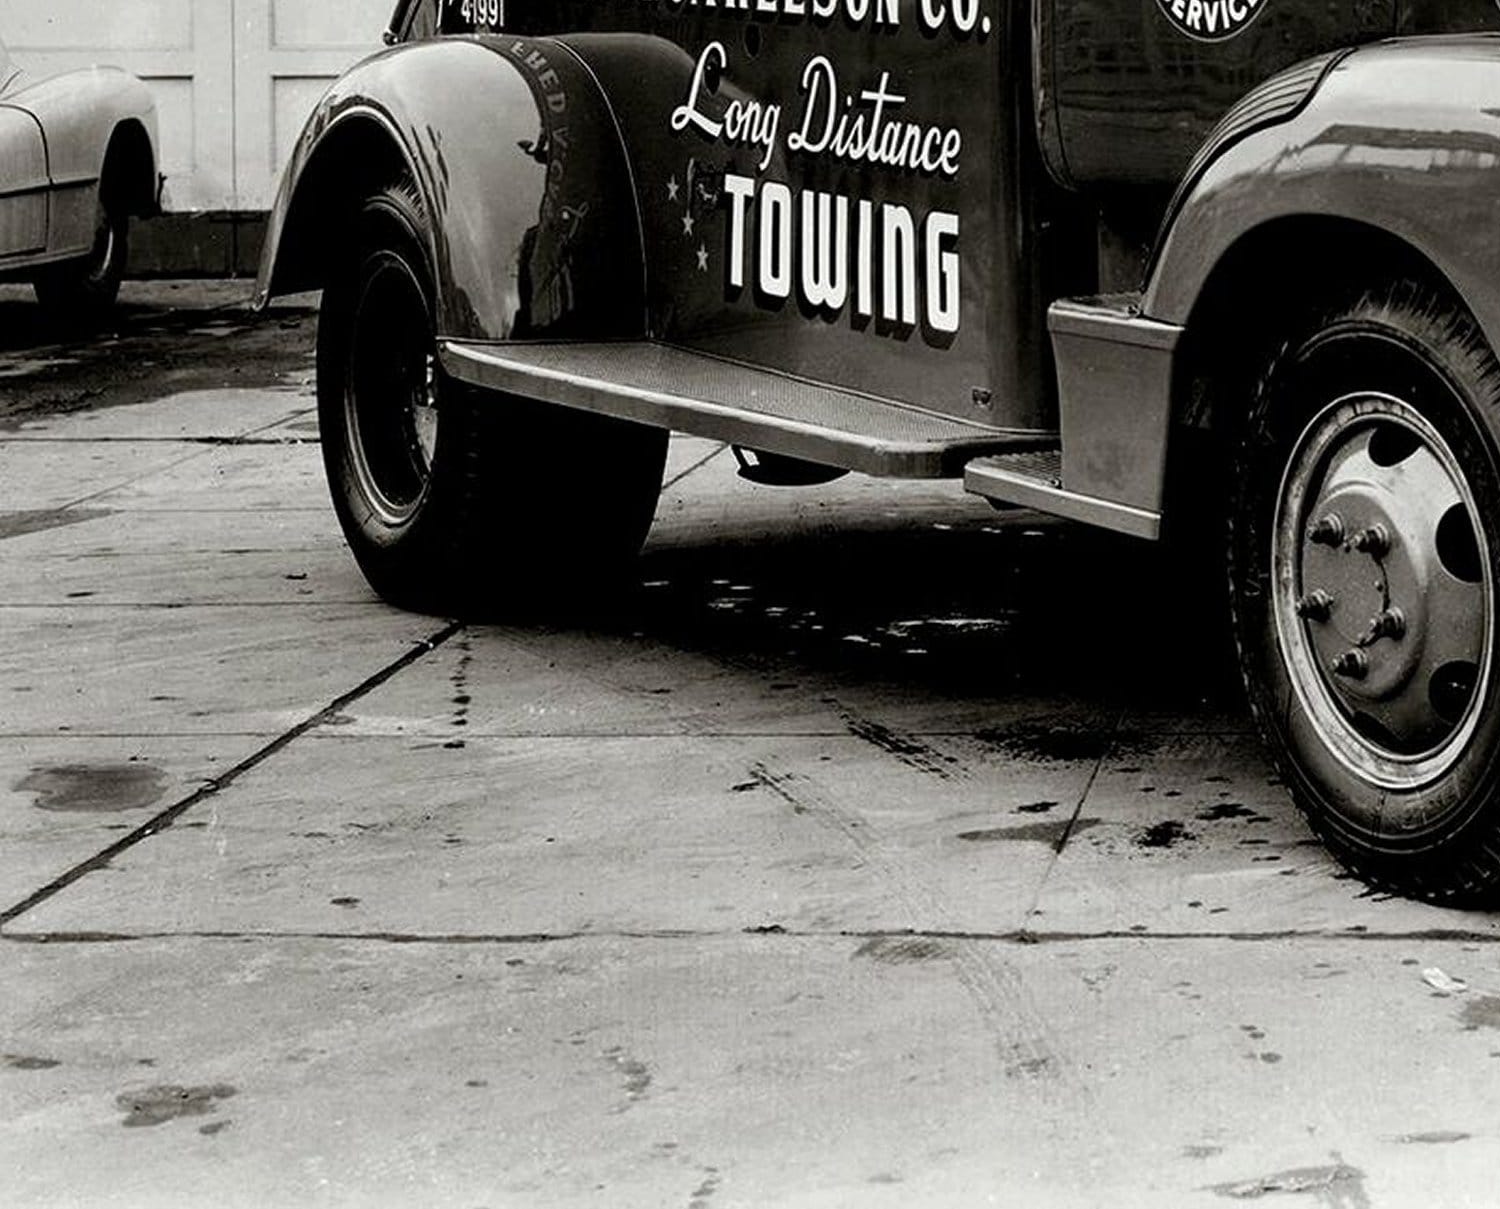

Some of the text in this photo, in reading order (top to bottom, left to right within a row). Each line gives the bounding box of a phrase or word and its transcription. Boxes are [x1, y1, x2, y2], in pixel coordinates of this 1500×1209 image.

[670, 40, 961, 175] Long Distance
[722, 173, 961, 335] TOWING
